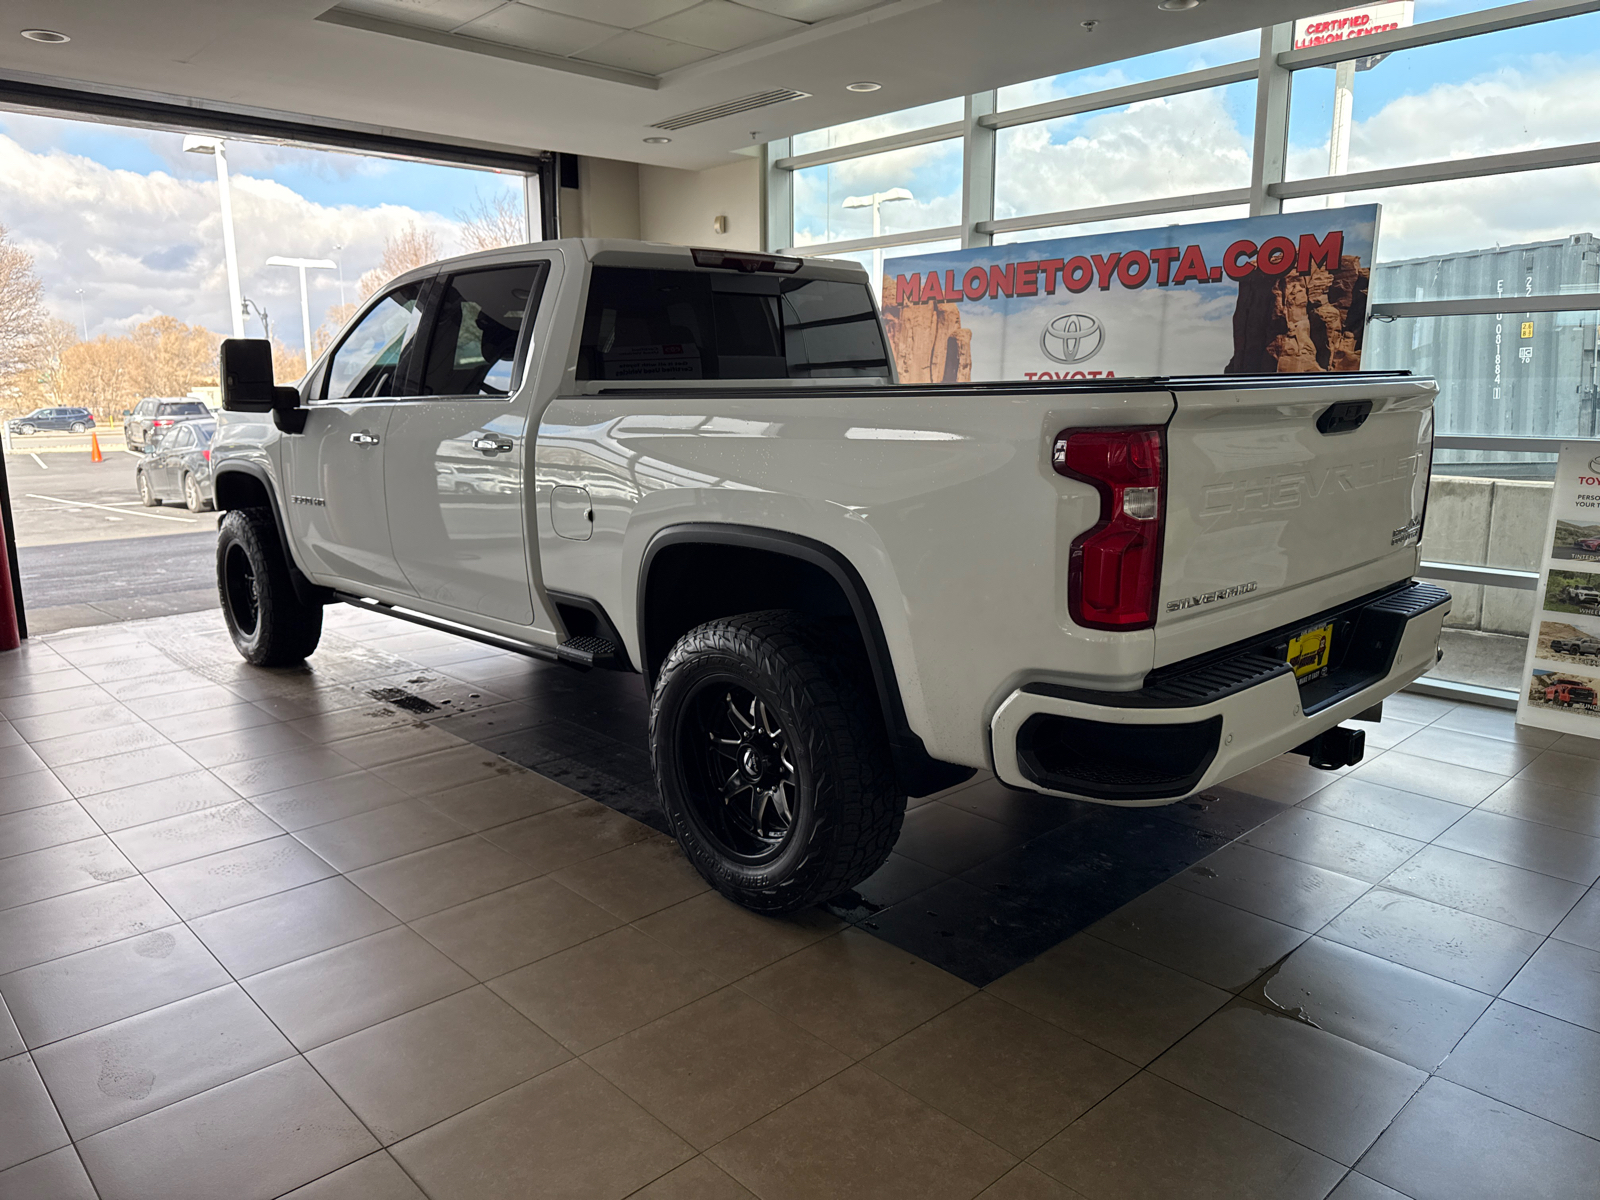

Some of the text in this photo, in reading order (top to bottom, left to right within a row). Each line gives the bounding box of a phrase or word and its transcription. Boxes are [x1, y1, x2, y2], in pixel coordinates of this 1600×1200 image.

[1306, 14, 1370, 35] CERTIFIED
[897, 231, 1344, 305] MALONETOYOTA.COM
[1166, 581, 1258, 613] SILVERADO
